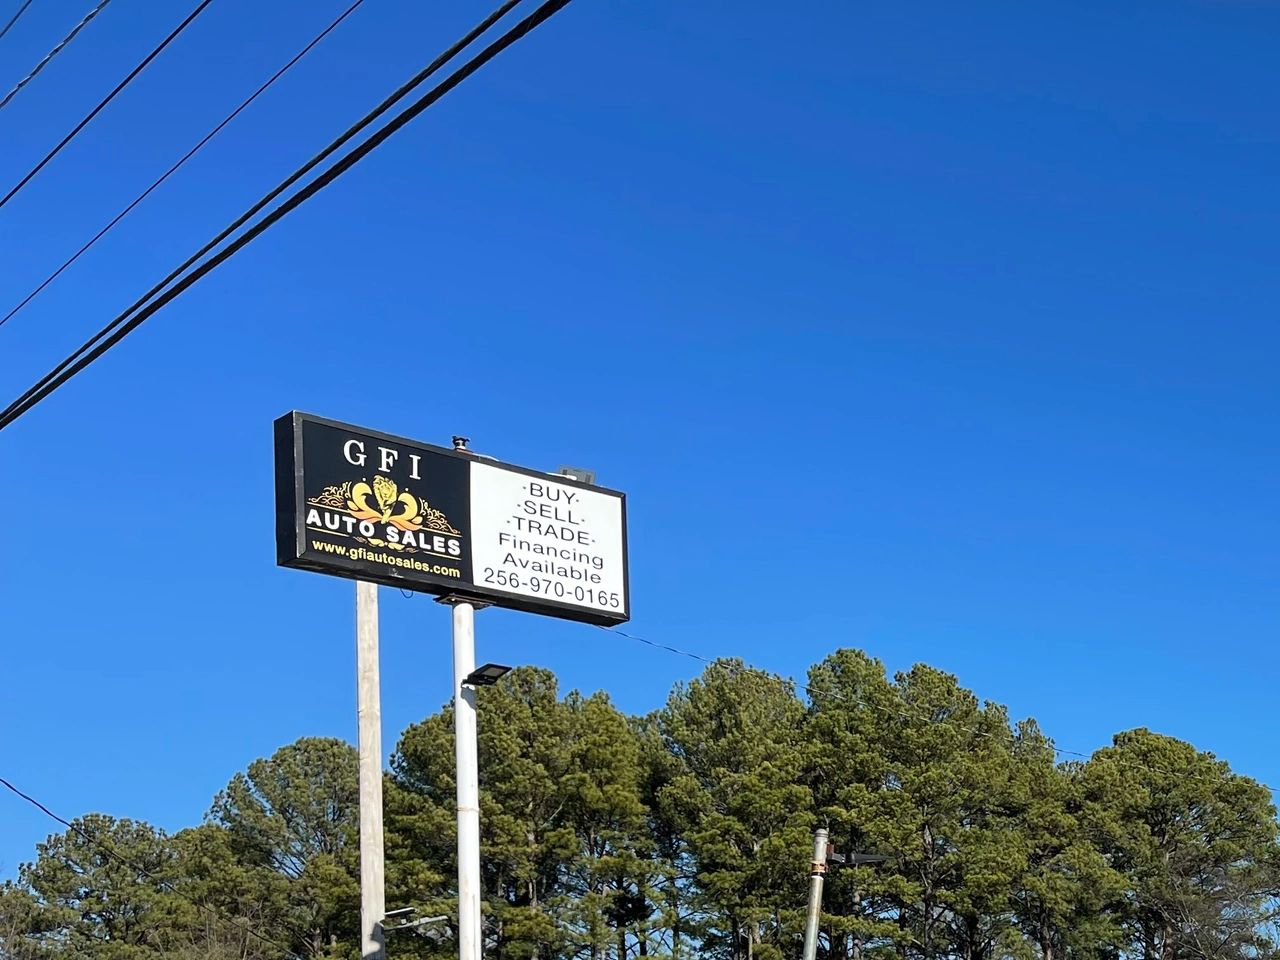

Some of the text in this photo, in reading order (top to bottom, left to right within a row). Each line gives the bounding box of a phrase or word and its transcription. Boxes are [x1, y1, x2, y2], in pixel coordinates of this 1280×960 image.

[530, 482, 576, 505] BUY
[523, 500, 580, 525] SELL
[306, 508, 461, 556] AUTO SALES
[512, 515, 590, 546] TRADE
[312, 540, 461, 578] www.gfiautosales.com
[499, 532, 604, 569] Financing
[503, 552, 602, 584] Available
[484, 567, 620, 608] 256-970-0165
